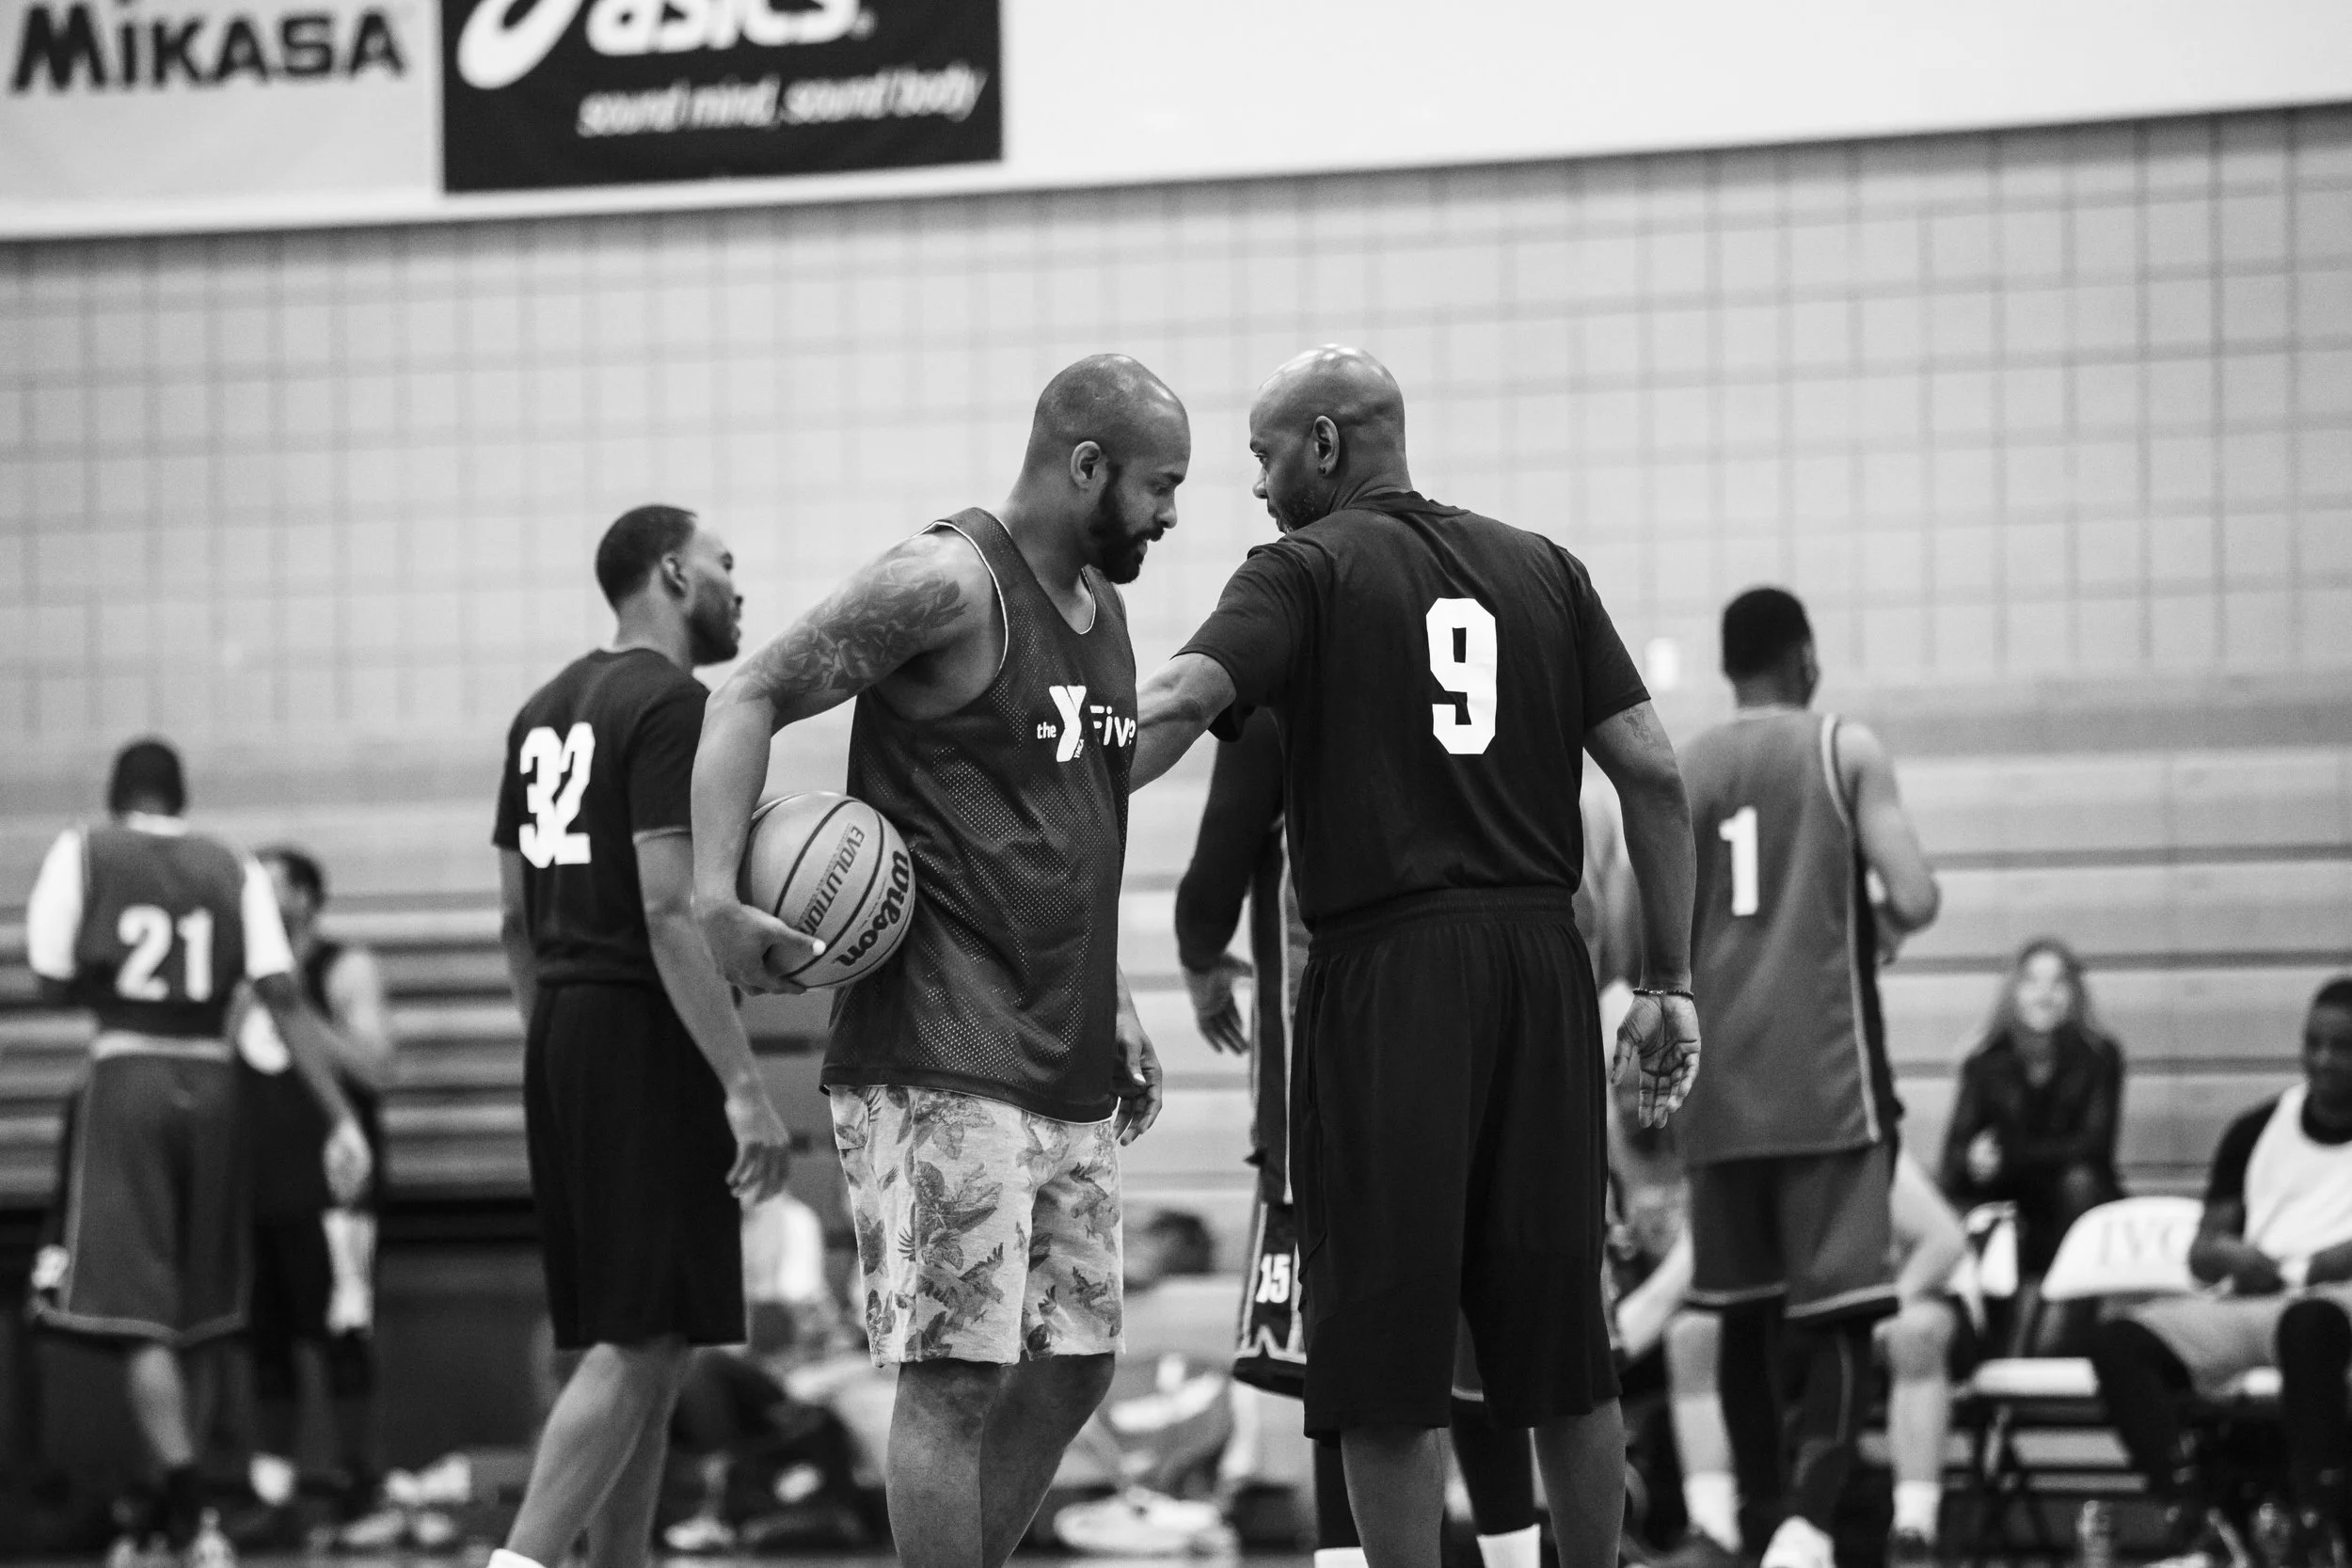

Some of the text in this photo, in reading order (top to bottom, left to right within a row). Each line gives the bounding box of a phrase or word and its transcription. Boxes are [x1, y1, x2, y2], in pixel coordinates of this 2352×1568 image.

[576, 77, 691, 138] sound
[782, 66, 893, 126] sound
[1425, 597, 1498, 755] 9
[1036, 721, 1057, 739] the
[518, 721, 596, 868] 32
[1718, 805, 1759, 916] 1
[116, 903, 215, 1004] 21
[1255, 1253, 1291, 1304] 15
